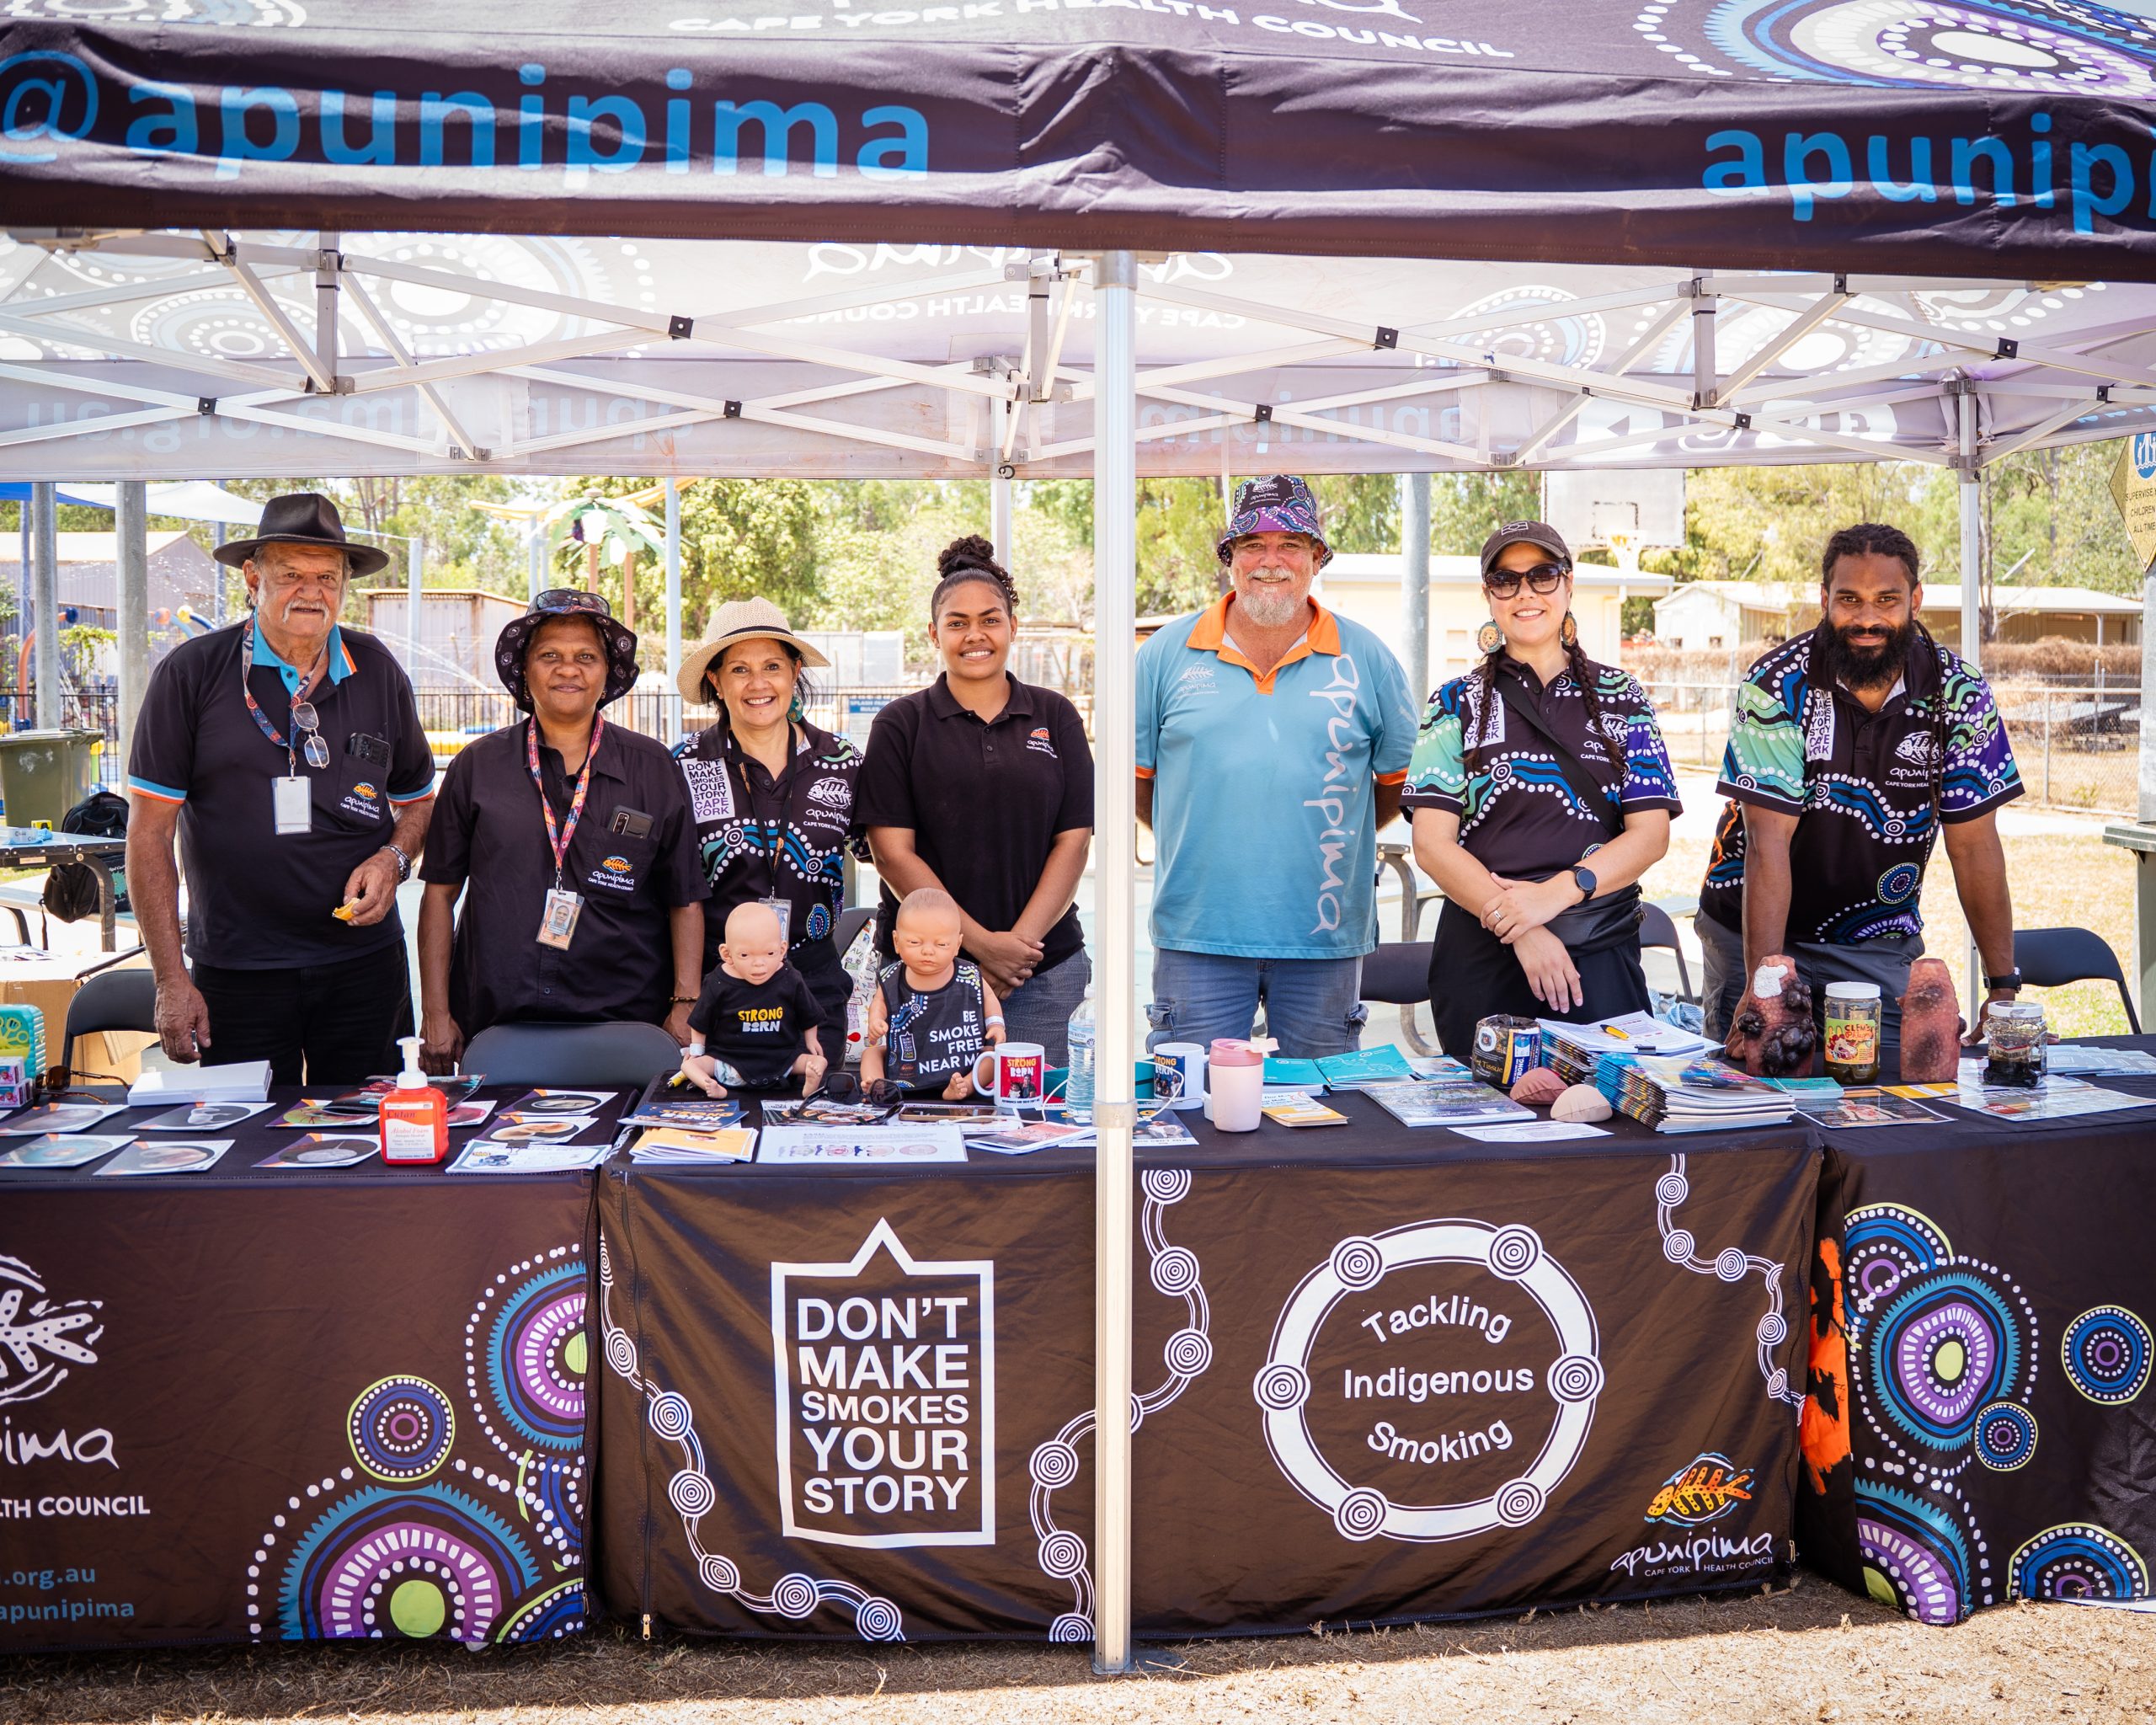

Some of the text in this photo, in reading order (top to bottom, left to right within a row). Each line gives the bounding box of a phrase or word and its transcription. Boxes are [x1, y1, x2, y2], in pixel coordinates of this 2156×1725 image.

[668, 15, 822, 30] CAPE
[834, 2, 1003, 28] YORK
[1252, 15, 1514, 57] COUNCIL
[0, 51, 928, 190] @apunipima
[686, 760, 720, 772] DON'T
[689, 766, 723, 780] MAKE
[691, 775, 725, 786] SMOKES
[691, 782, 726, 793] YOUR
[694, 790, 727, 801] STORY
[694, 797, 729, 810] CAPE
[1304, 654, 1359, 936] apunipima
[694, 806, 729, 818] YORK
[592, 870, 635, 886] apunipima
[738, 1006, 783, 1022] STRONG
[963, 1010, 978, 1023] BE
[742, 1020, 781, 1032] BORN
[929, 1023, 981, 1043] SMOKE
[947, 1037, 984, 1055] FREE
[918, 1055, 961, 1074] NEAR
[1006, 1058, 1037, 1068] STRONG
[798, 1296, 969, 1341] DON'T
[1361, 1295, 1513, 1344] Tackling
[798, 1344, 969, 1390] MAKE
[1344, 1366, 1534, 1403] Indigenous
[801, 1390, 969, 1425] SMOKES
[803, 1426, 969, 1472] YOUR
[1367, 1419, 1513, 1464] Smoking
[803, 1475, 969, 1514] STORY
[38, 1495, 151, 1516] COUNCIL
[1610, 1526, 1773, 1577] apunipima
[1644, 1557, 1774, 1578] CAPE YORK HEALTH COUNCIL
